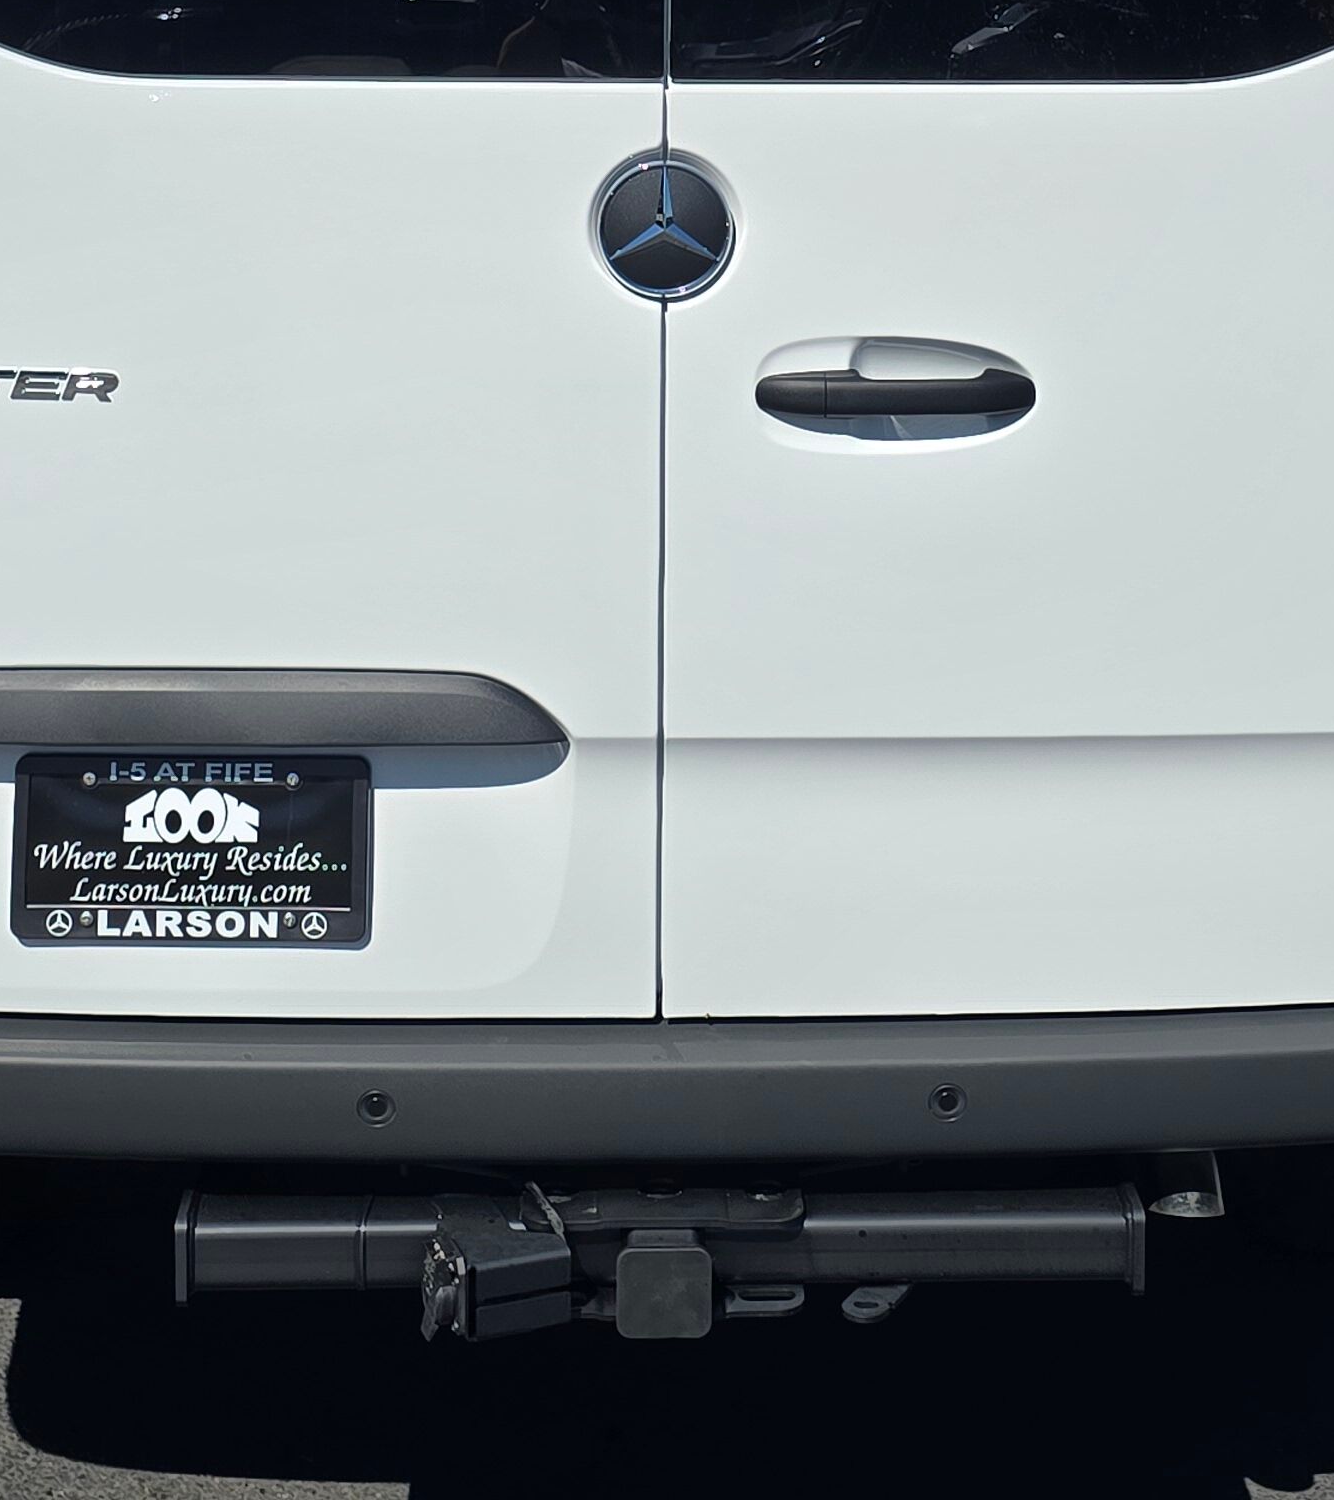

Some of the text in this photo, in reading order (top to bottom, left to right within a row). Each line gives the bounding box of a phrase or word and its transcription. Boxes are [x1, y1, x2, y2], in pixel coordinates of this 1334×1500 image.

[108, 762, 274, 783] I-5 AT FIFE
[33, 841, 117, 871] Where
[122, 844, 218, 881] Luxury
[69, 877, 312, 908] LarsonLuxury.com
[96, 909, 279, 939] LARSON
